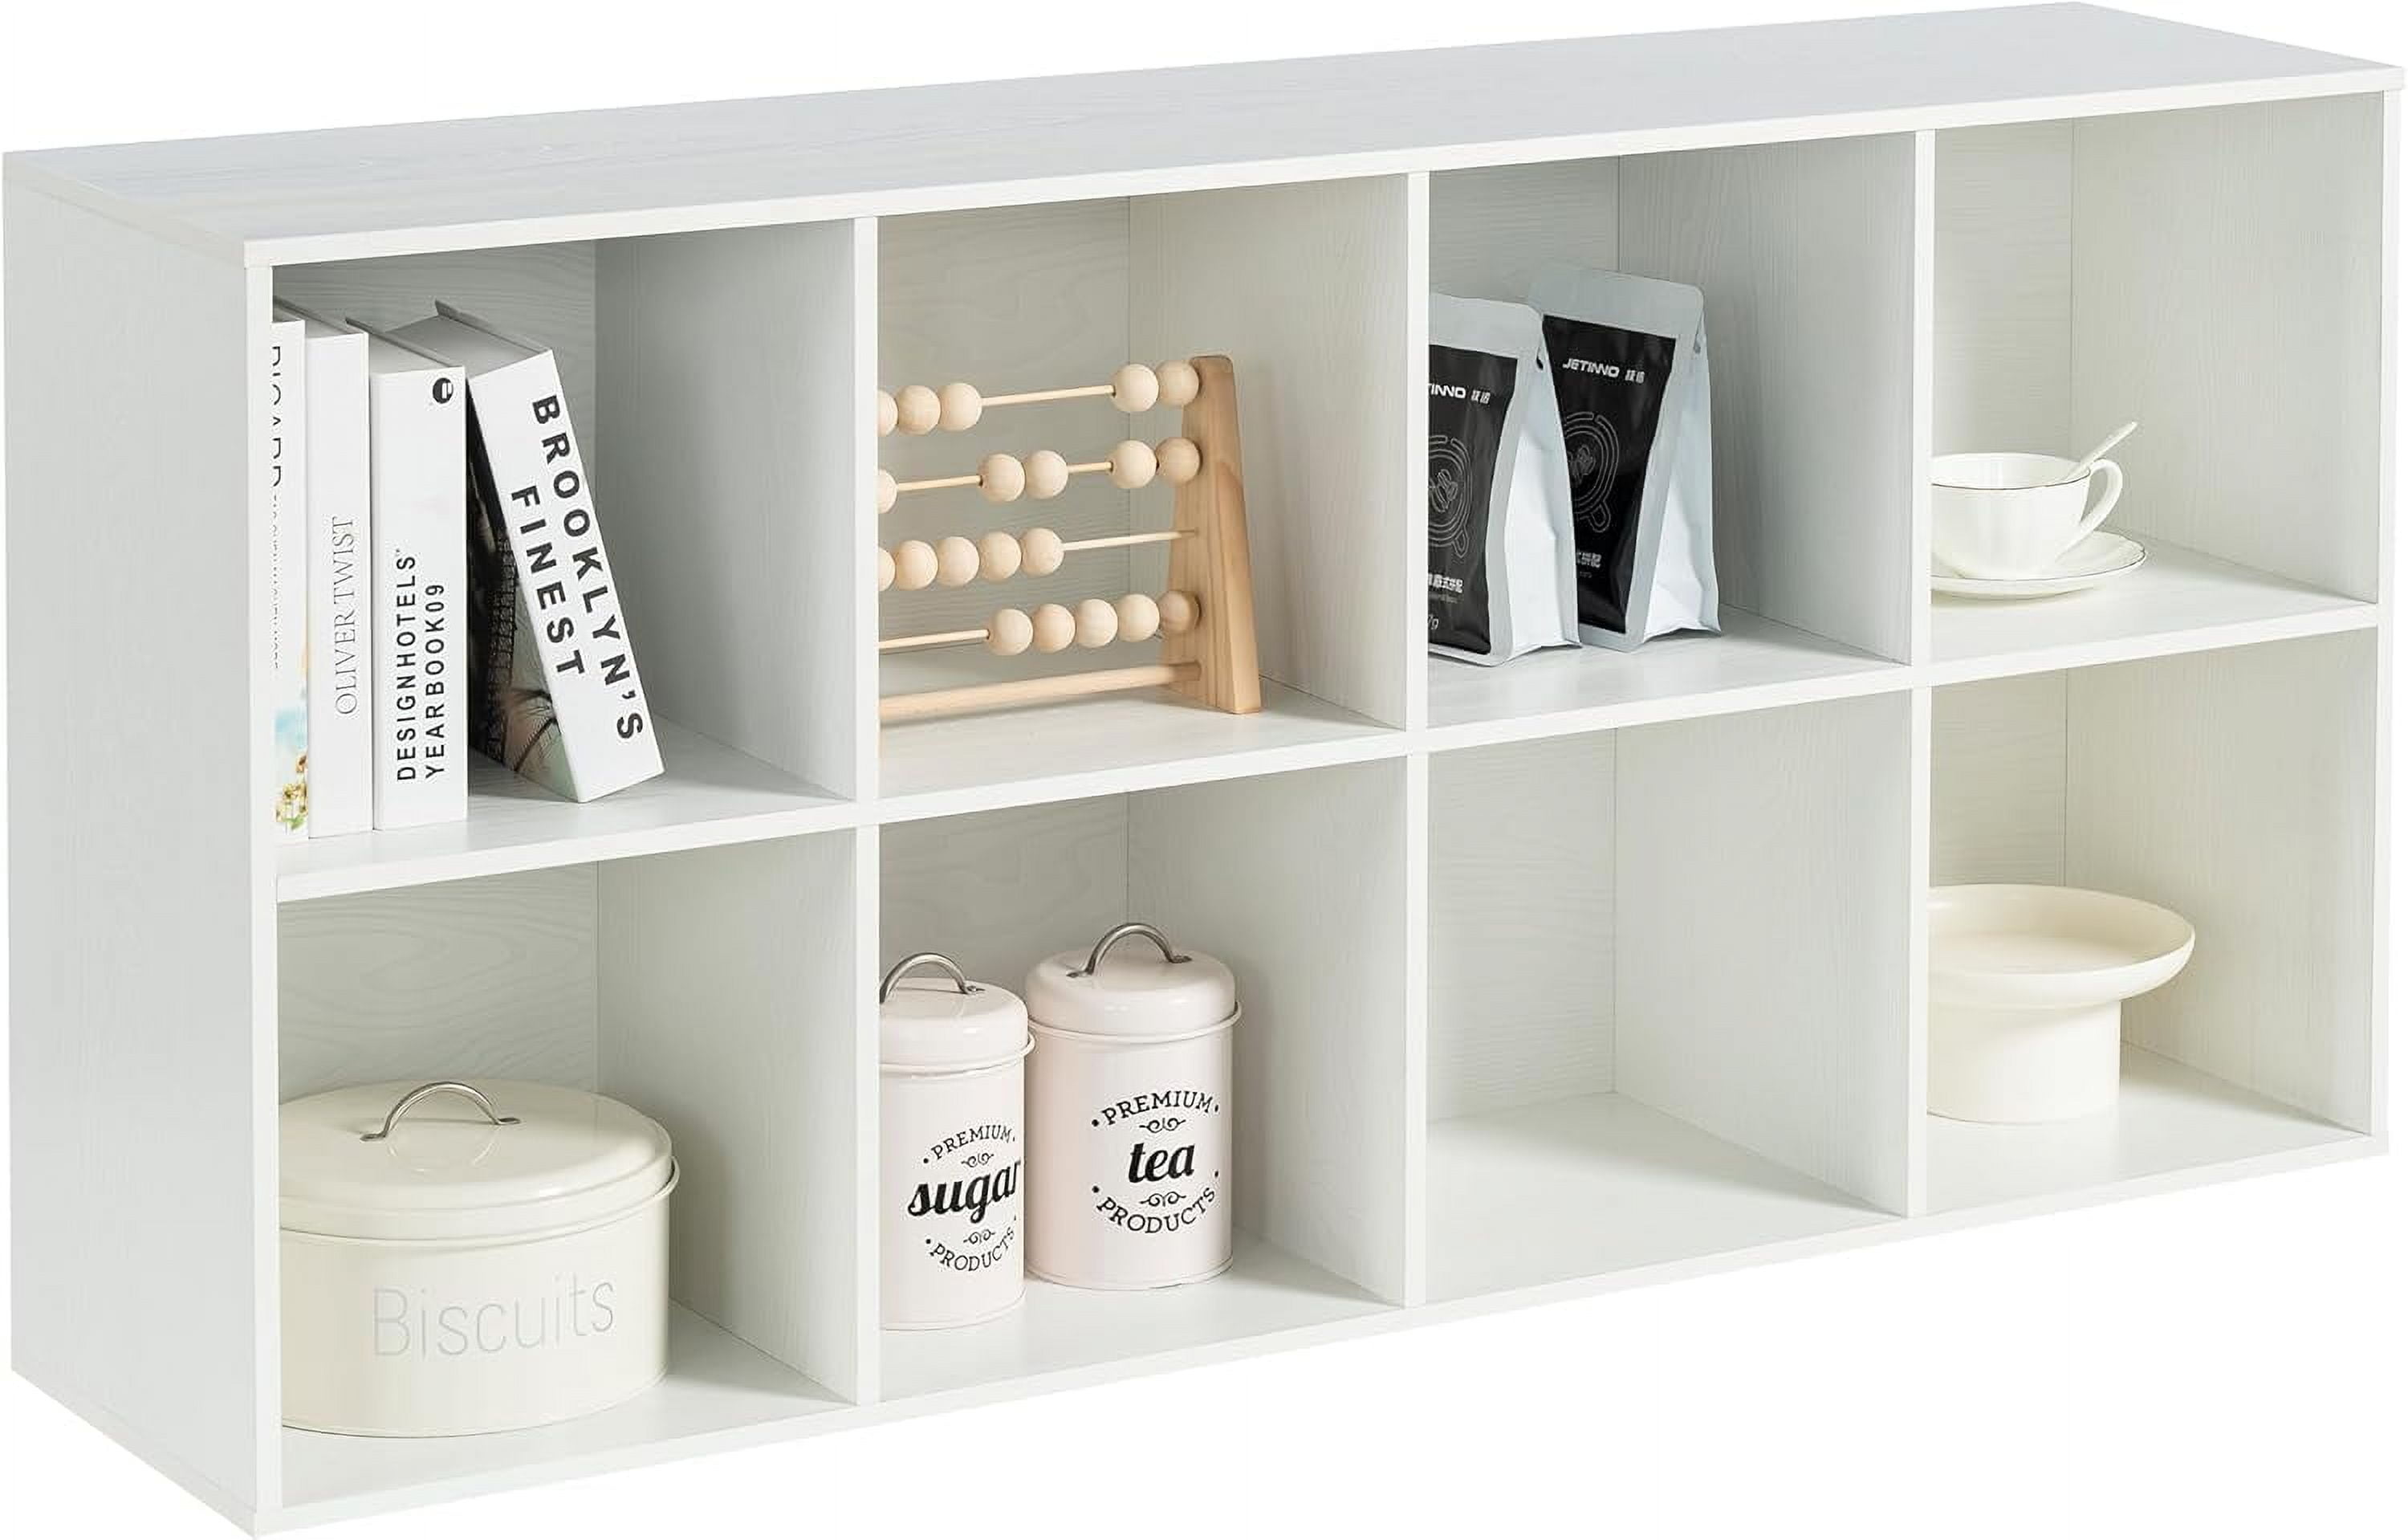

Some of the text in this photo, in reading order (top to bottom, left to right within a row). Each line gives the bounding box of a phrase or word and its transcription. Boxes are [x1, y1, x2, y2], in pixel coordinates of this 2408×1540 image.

[511, 485, 584, 674] FINEST
[531, 393, 645, 740] BROOKLYN'S
[331, 516, 358, 715] OLIVER TWIST
[425, 584, 445, 780] YEARBOOK09
[1101, 1090, 1212, 1126] PREMIUM
[931, 1124, 1013, 1161] PREMIUM
[1128, 1143, 1195, 1184] tea
[907, 1160, 1022, 1224] sugar
[1096, 1186, 1215, 1233] PRODUCTS
[929, 1228, 1015, 1272] PRODUCTS
[373, 1272, 614, 1357] Biscuits
